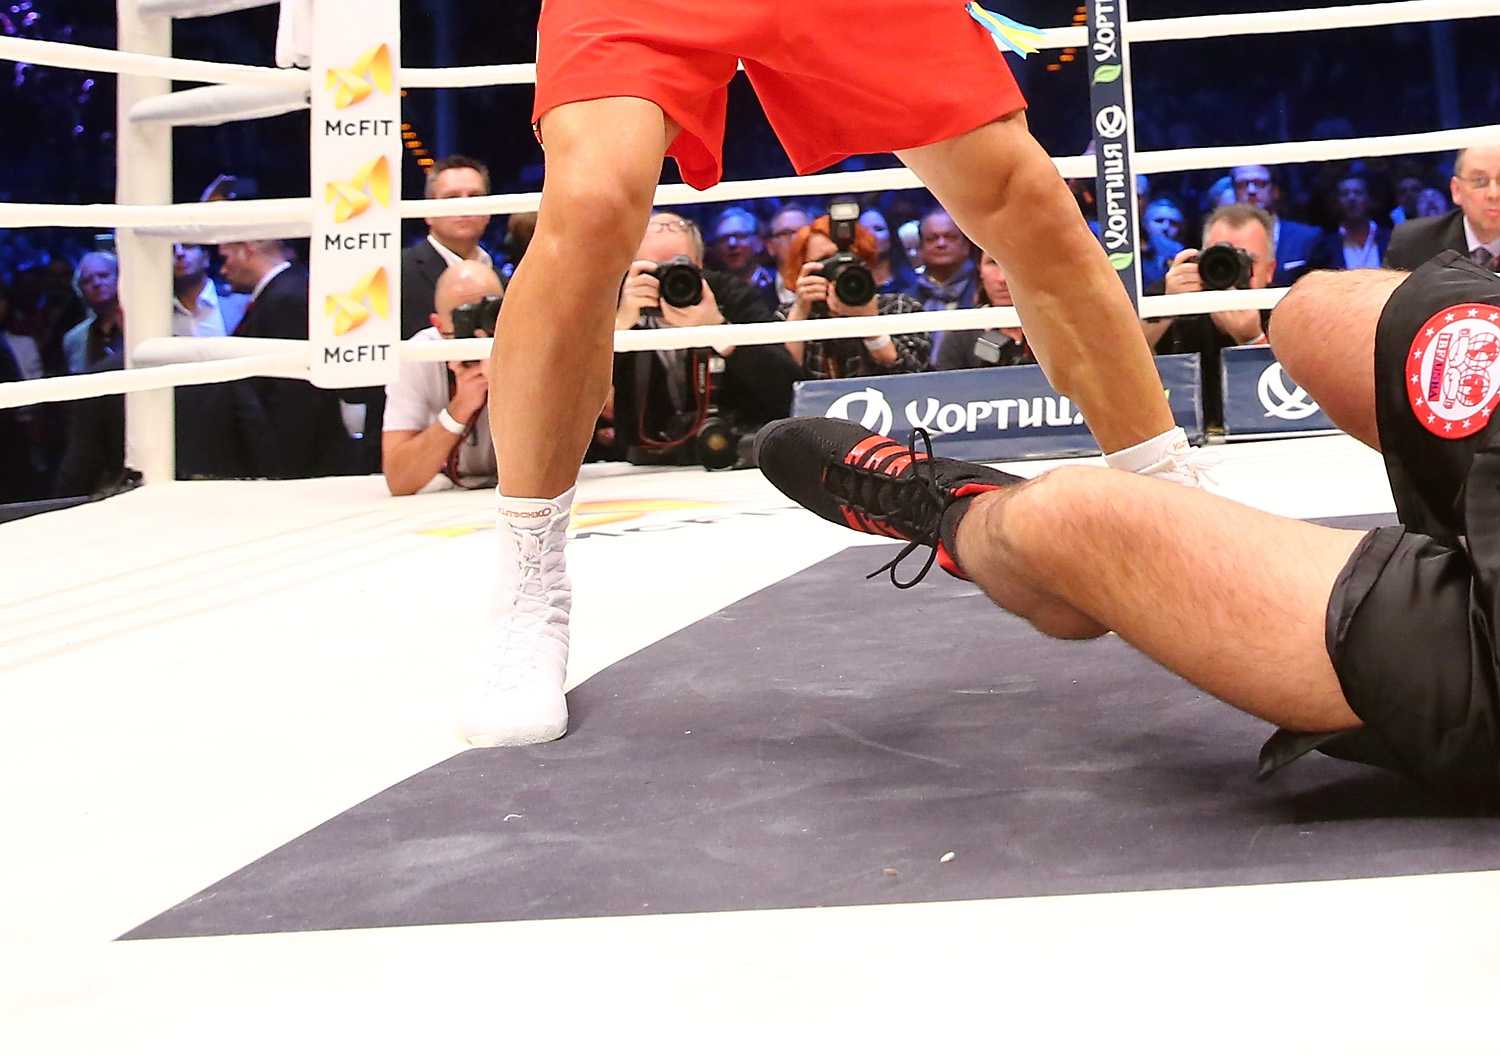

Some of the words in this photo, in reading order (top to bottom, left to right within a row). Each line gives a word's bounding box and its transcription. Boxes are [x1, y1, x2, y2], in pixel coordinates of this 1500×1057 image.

[325, 119, 393, 137] McFIT
[325, 232, 392, 250] McFIT
[324, 344, 391, 364] McFIT
[905, 396, 1085, 437] ХОРТИЦ
